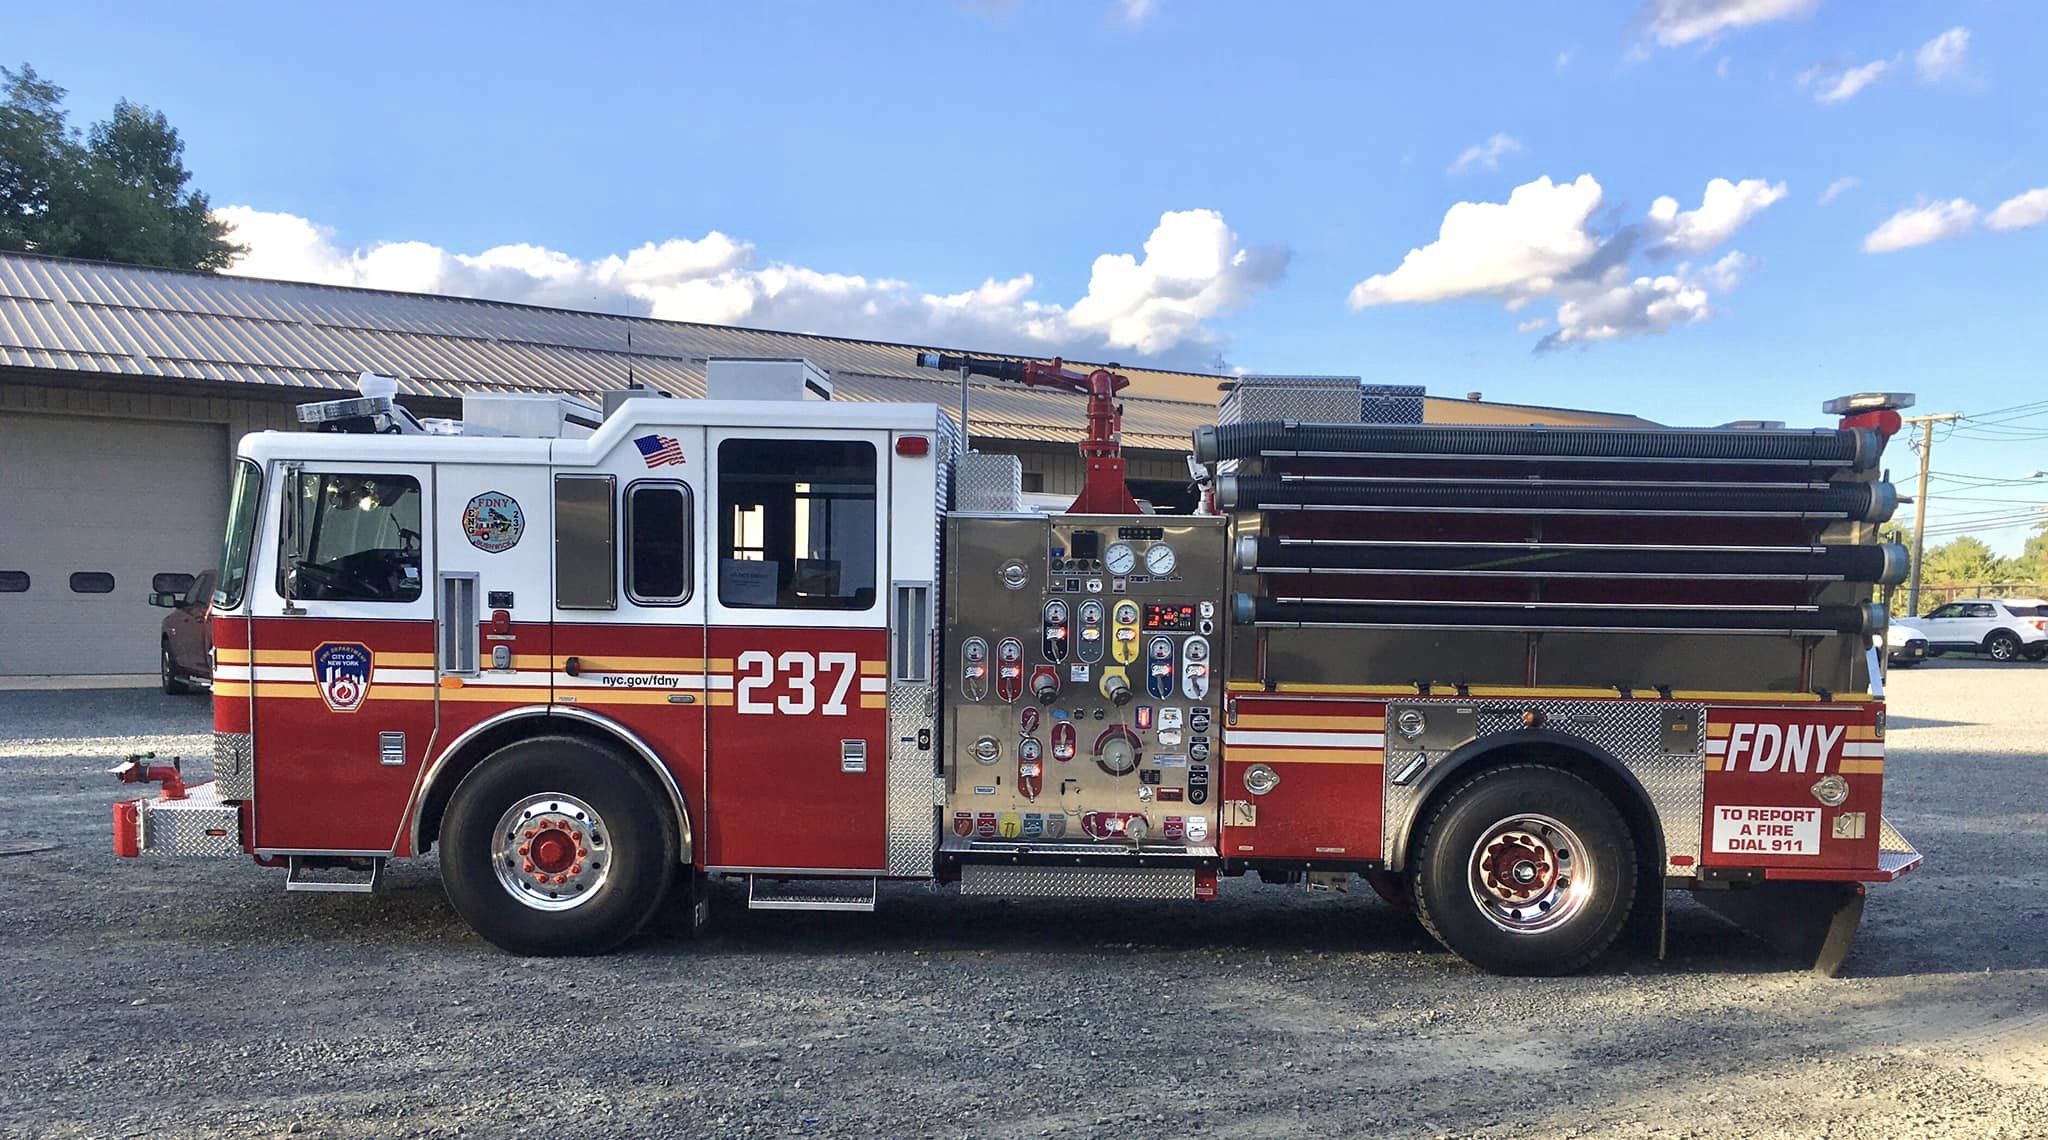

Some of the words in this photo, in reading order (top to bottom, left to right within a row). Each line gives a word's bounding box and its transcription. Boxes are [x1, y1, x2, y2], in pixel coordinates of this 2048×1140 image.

[479, 498, 508, 507] FDNY
[602, 674, 679, 687] nyc.gov/fdny
[737, 650, 857, 716] 237
[1725, 723, 1845, 774] FDNY
[1721, 808, 1743, 821] TO
[1747, 809, 1816, 823] REPORT
[1740, 824, 1752, 836] A
[1757, 824, 1794, 837] FIRE
[1728, 838, 1767, 851] DIAL
[1771, 839, 1803, 852] 911
